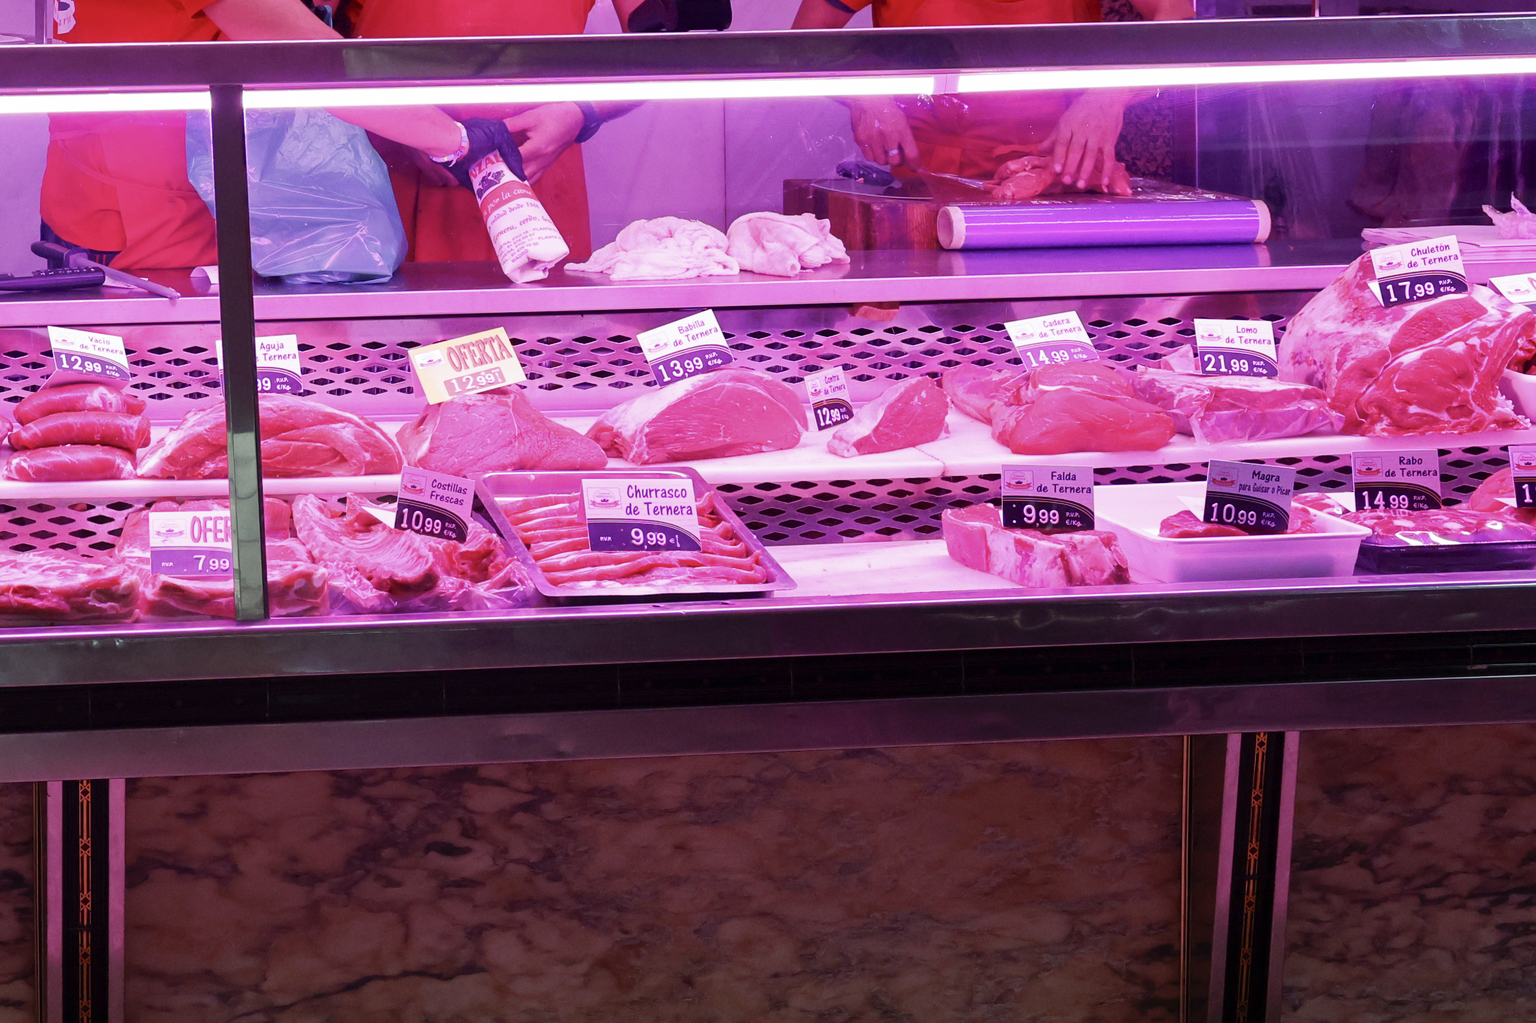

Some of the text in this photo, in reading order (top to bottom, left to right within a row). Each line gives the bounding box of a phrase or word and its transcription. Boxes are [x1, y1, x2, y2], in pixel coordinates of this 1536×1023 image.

[1411, 243, 1450, 257] Chuletón
[1408, 254, 1458, 268] de Ternera
[1386, 282, 1434, 302] 17,99
[678, 320, 705, 334] Babilla
[1042, 318, 1070, 328] Cadera
[1236, 326, 1258, 334] Lomo
[673, 326, 718, 347] de Ternera
[1050, 326, 1082, 336] Ternera
[88, 336, 110, 345] Vacio
[260, 342, 284, 352] Aguja
[1225, 336, 1272, 345] de Ternera
[92, 344, 124, 355] Ternera
[446, 334, 513, 372] OFERTA
[60, 354, 102, 374] 12,99
[262, 353, 296, 362] Ternera
[1204, 354, 1249, 374] 21,99
[658, 356, 704, 382] 13,99
[829, 384, 846, 394] Ternera
[1399, 456, 1423, 465] Rabo
[1051, 471, 1077, 481] Falda
[1252, 470, 1280, 483] Magra
[1385, 468, 1438, 477] de Ternera
[431, 479, 468, 494] Costillas
[626, 485, 687, 498] Churrasco
[1036, 484, 1092, 494] de Ternera
[1238, 484, 1250, 492] para
[1252, 483, 1270, 494] Guisar
[1276, 486, 1291, 496] Picar
[430, 490, 464, 506] Frescas
[626, 502, 693, 516] de Ternera
[1023, 504, 1060, 527] 9,99
[1210, 502, 1256, 526] 10,99
[400, 508, 442, 534] 10,99
[190, 516, 230, 543] OFER
[631, 528, 666, 550] 9,99
[193, 555, 230, 572] 7,99
